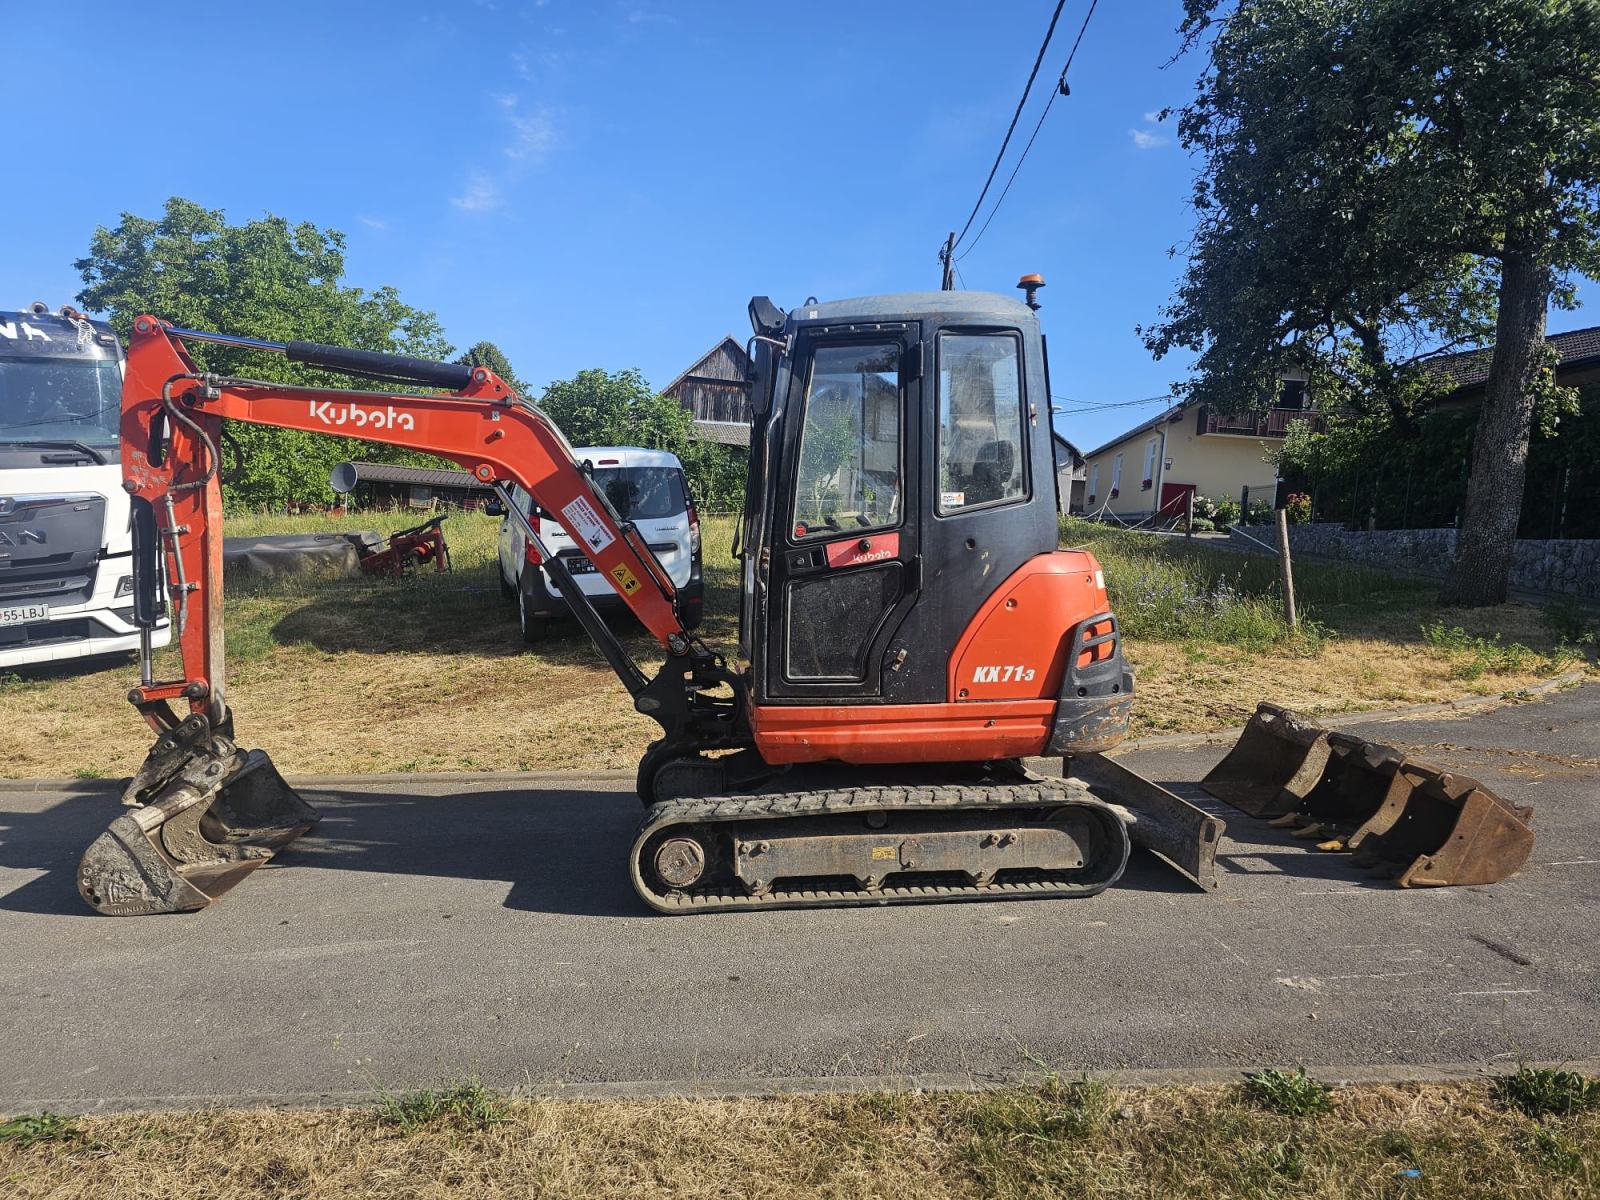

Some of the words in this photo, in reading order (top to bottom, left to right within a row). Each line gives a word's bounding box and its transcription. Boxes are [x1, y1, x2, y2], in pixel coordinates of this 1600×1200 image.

[310, 400, 414, 430] Kubota
[853, 550, 891, 562] Kubota
[972, 665, 1001, 683] KX
